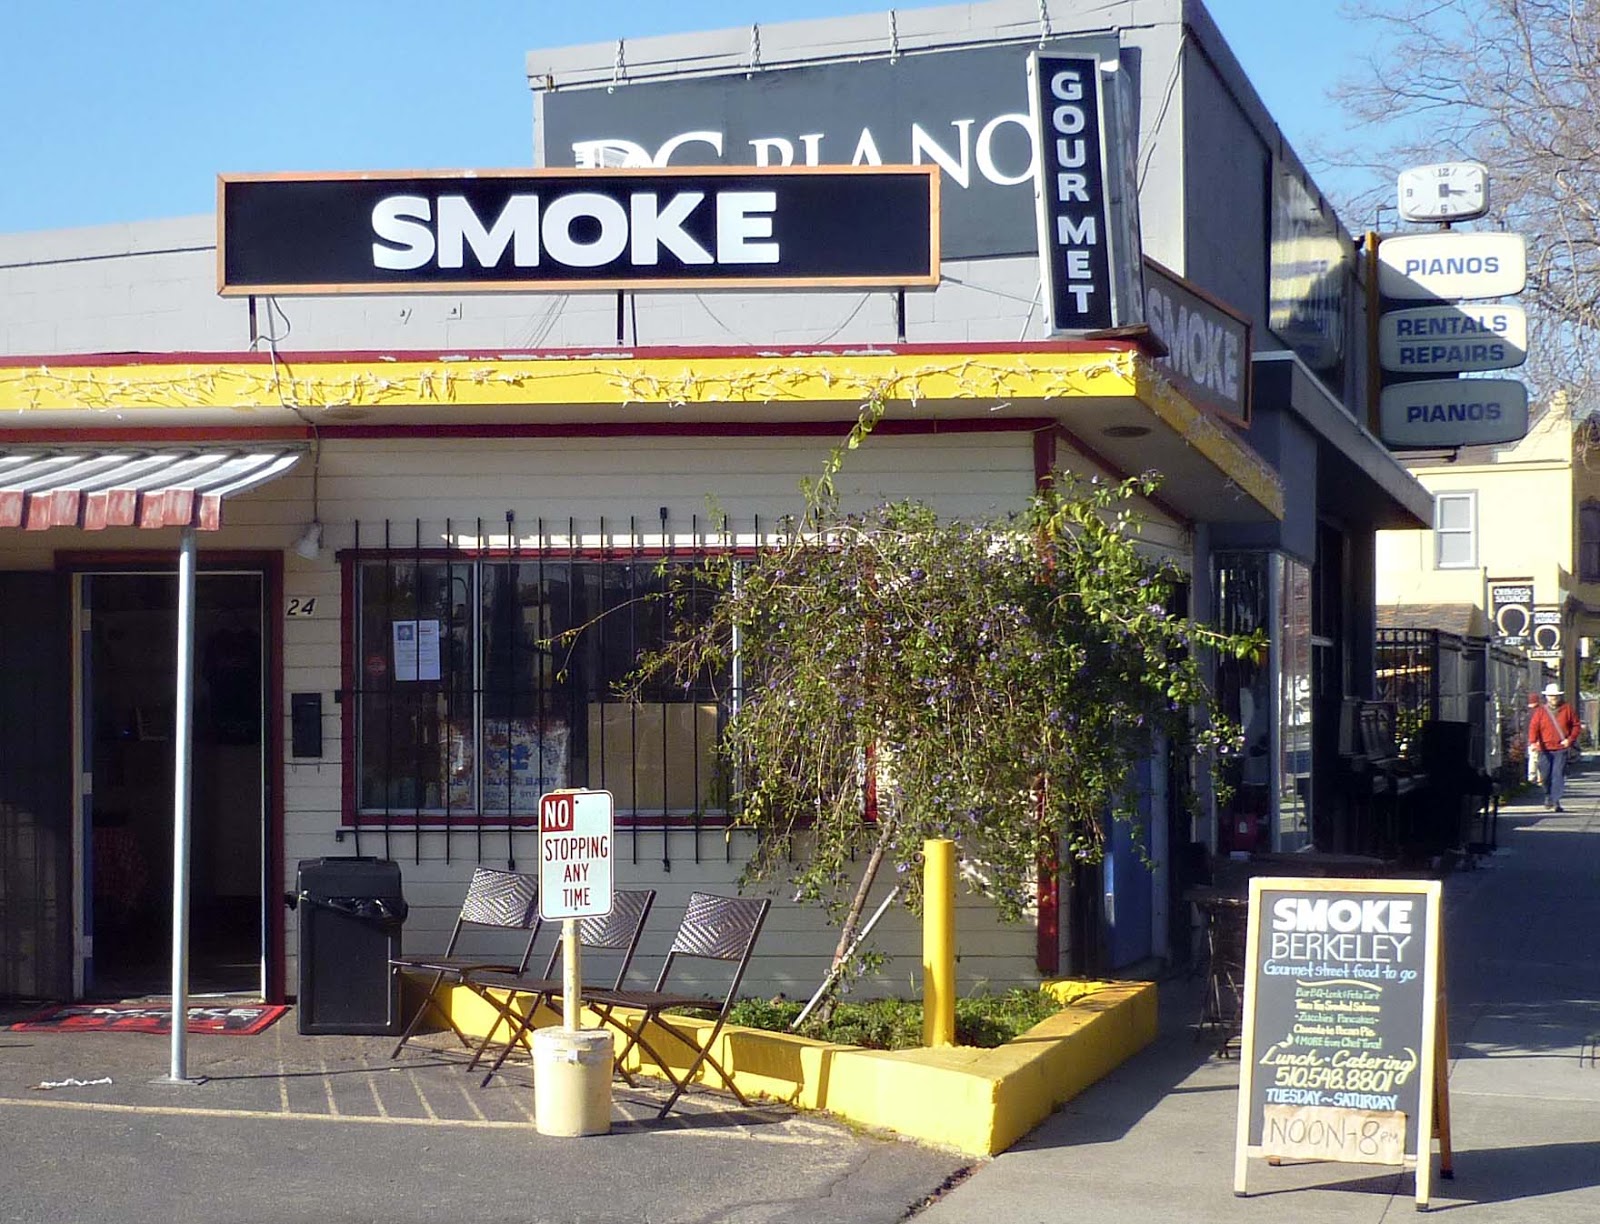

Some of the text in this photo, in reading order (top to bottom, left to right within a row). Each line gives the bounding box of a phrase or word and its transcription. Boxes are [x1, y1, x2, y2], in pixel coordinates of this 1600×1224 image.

[1437, 167, 1450, 177] 12
[1050, 71, 1097, 314] GOURMET
[1474, 183, 1482, 193] 3
[371, 191, 780, 270] SMOKE
[1405, 256, 1500, 277] PIANOS
[1397, 315, 1508, 337] RENTALS
[1147, 287, 1238, 401] SMOKE
[1401, 344, 1504, 365] REPAIRS
[1407, 402, 1502, 424] PIANOS
[287, 598, 315, 616] 24
[544, 800, 569, 828] NO
[545, 836, 608, 861] STOPPING
[563, 863, 589, 882] ANY
[562, 888, 591, 907] TIME
[1272, 898, 1413, 933] SMOKE
[1271, 932, 1411, 963] BERKELEY
[1263, 959, 1313, 978] Gourmet
[1352, 962, 1380, 979] food
[1381, 964, 1396, 980] to
[1399, 968, 1418, 984] go
